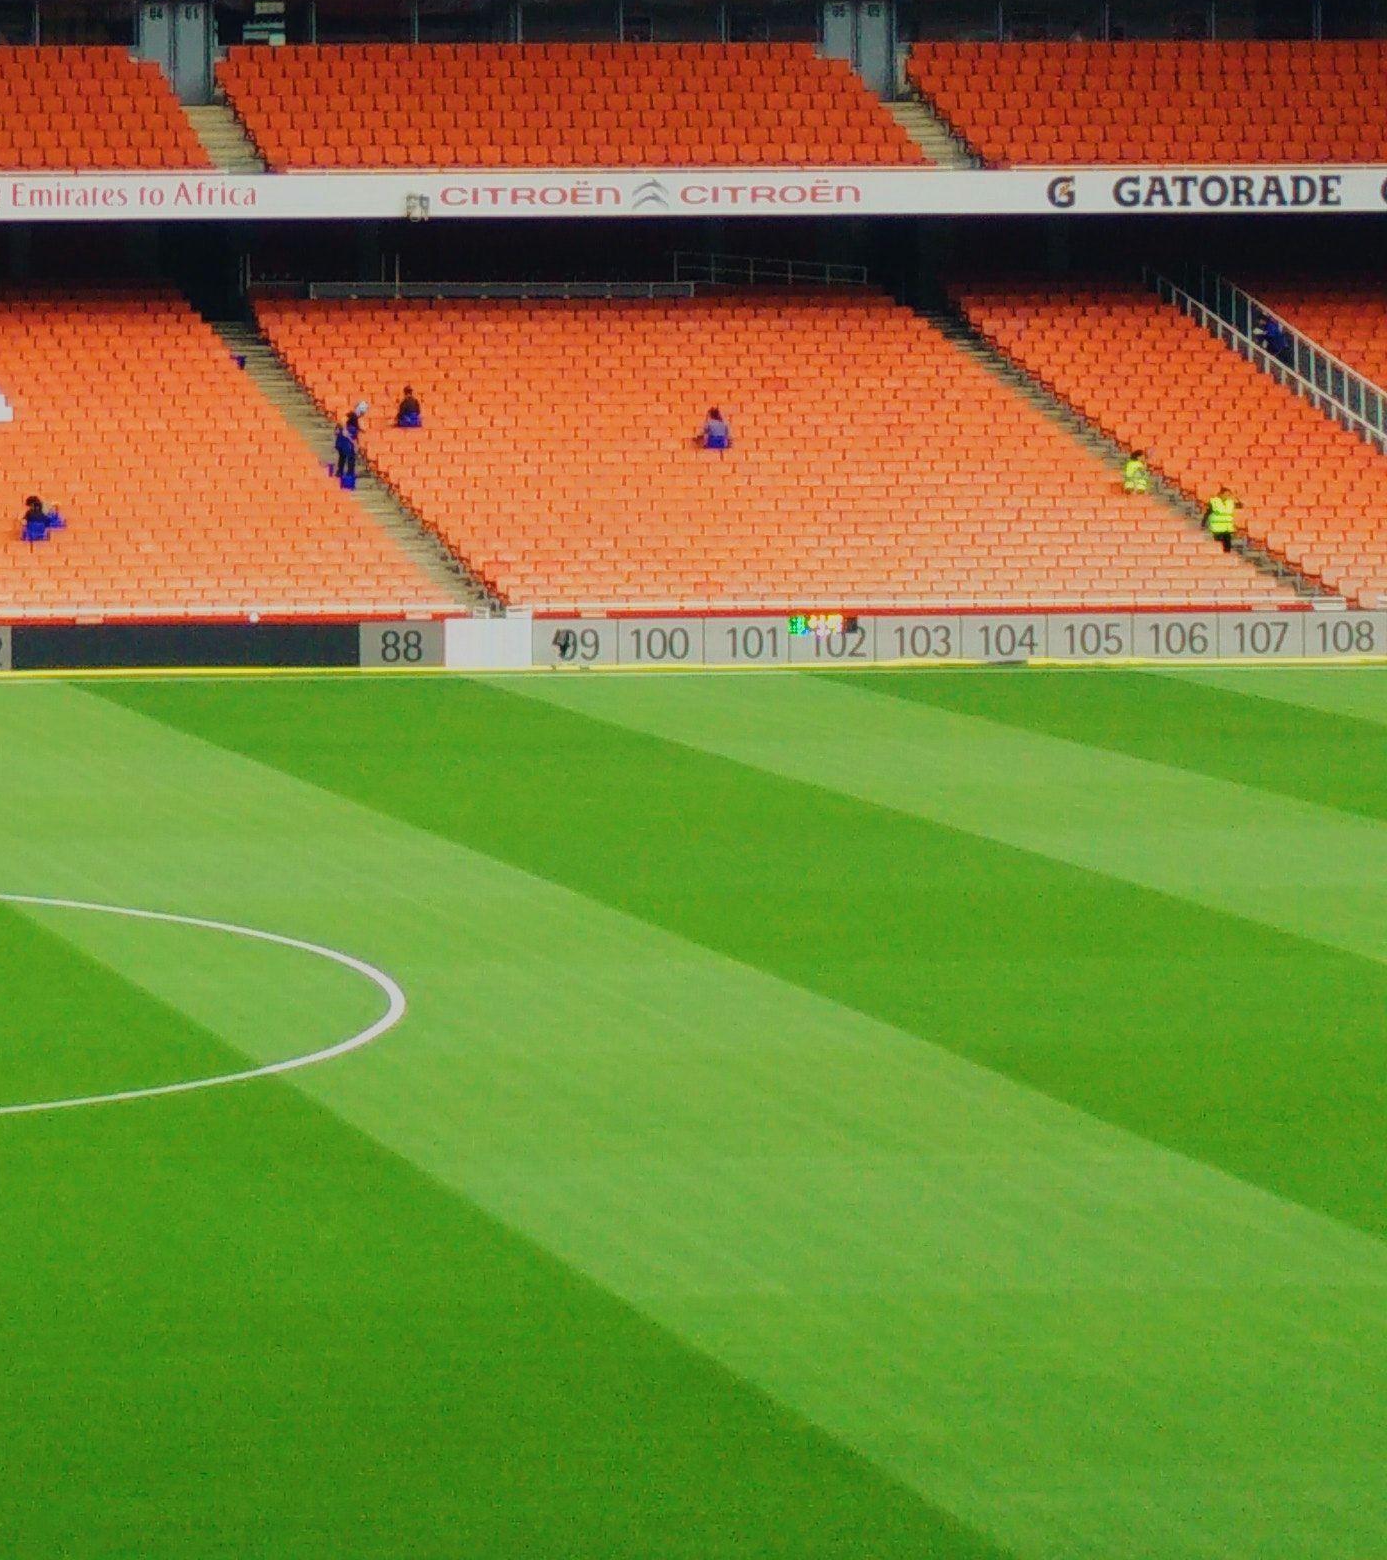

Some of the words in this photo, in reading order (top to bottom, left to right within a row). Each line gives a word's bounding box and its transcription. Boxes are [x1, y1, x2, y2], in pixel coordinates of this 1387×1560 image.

[12, 182, 127, 207] Emirates
[138, 185, 165, 207] to
[173, 181, 257, 207] Africa
[1046, 175, 1076, 208] G
[1111, 174, 1342, 207] GATORADE
[382, 631, 424, 664] 88
[631, 628, 691, 661] 100
[727, 627, 779, 660] 101
[895, 626, 953, 659] 103
[980, 625, 1040, 657] 104
[1065, 623, 1124, 657] 105
[1150, 623, 1210, 656] 106
[1234, 622, 1290, 655] 107
[1317, 621, 1376, 654] 108
